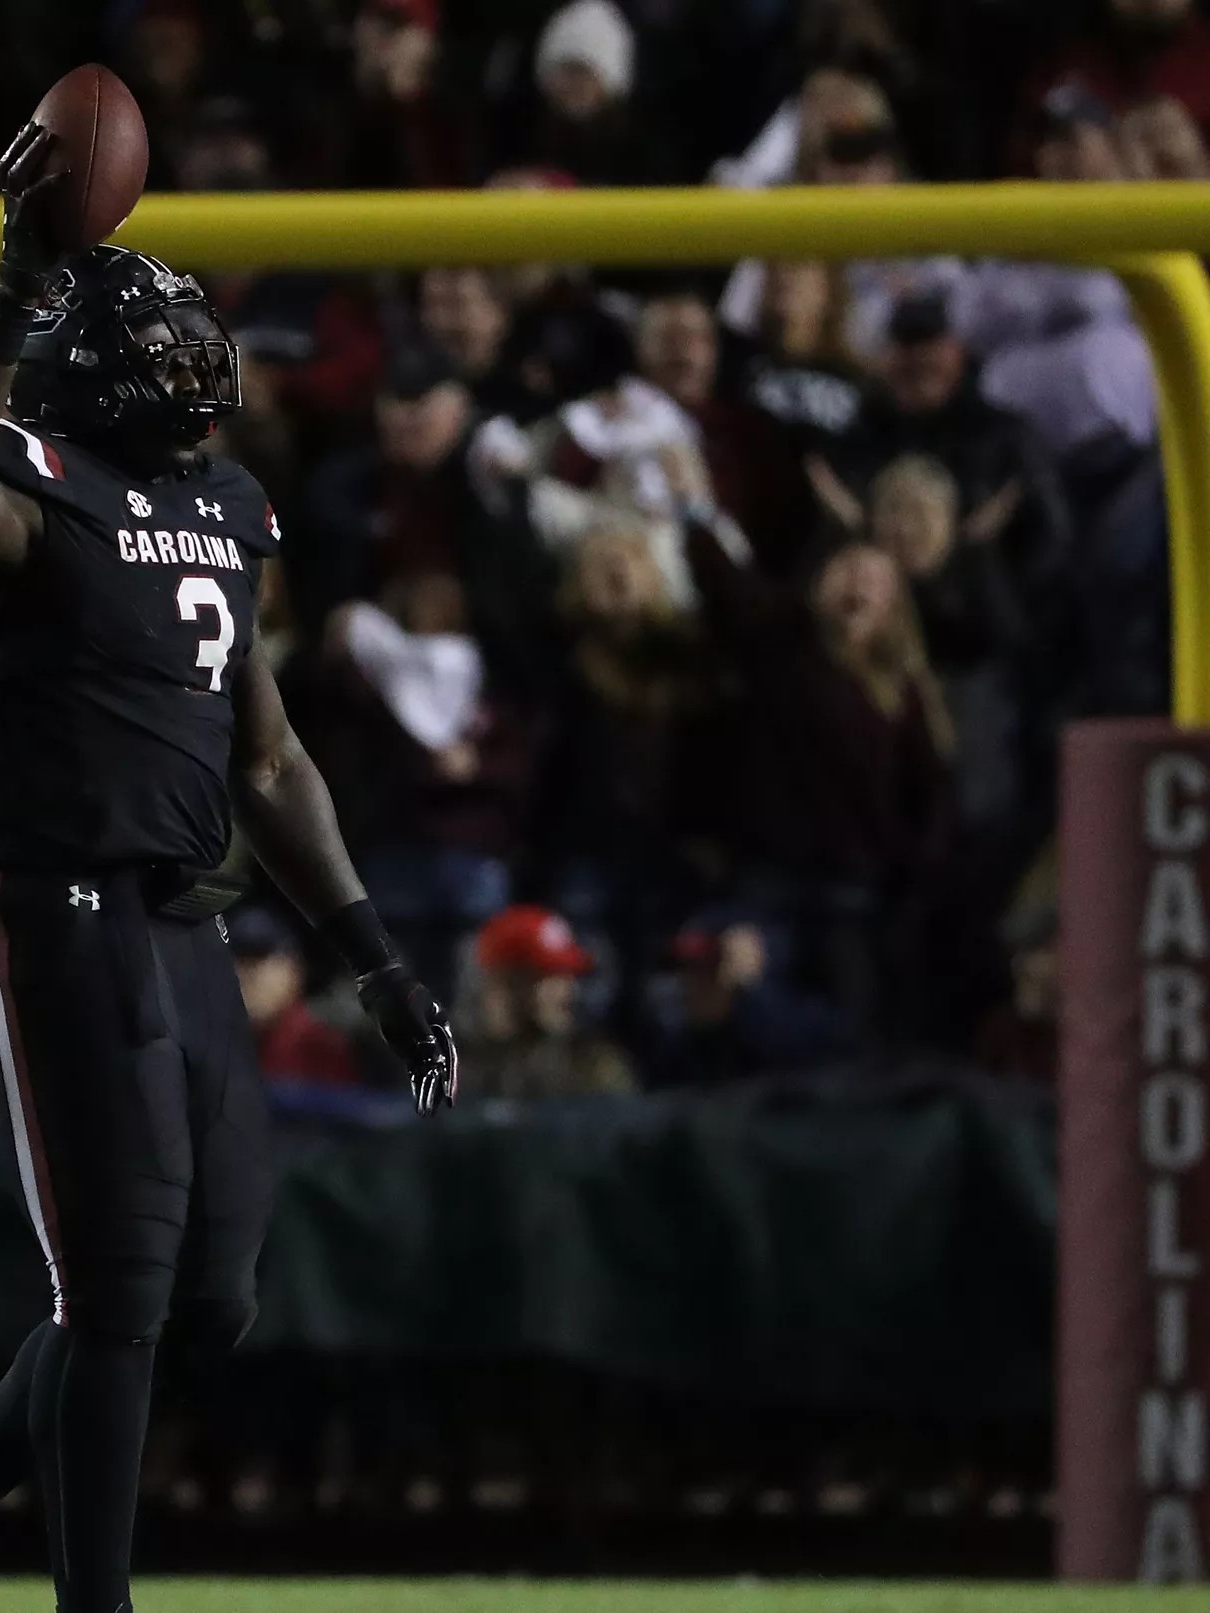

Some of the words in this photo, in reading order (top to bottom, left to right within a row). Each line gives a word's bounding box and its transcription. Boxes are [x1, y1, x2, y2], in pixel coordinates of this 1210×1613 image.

[116, 529, 245, 572] CAROLINA
[176, 575, 236, 693] 3
[1137, 750, 1208, 1585] CAROLINA
